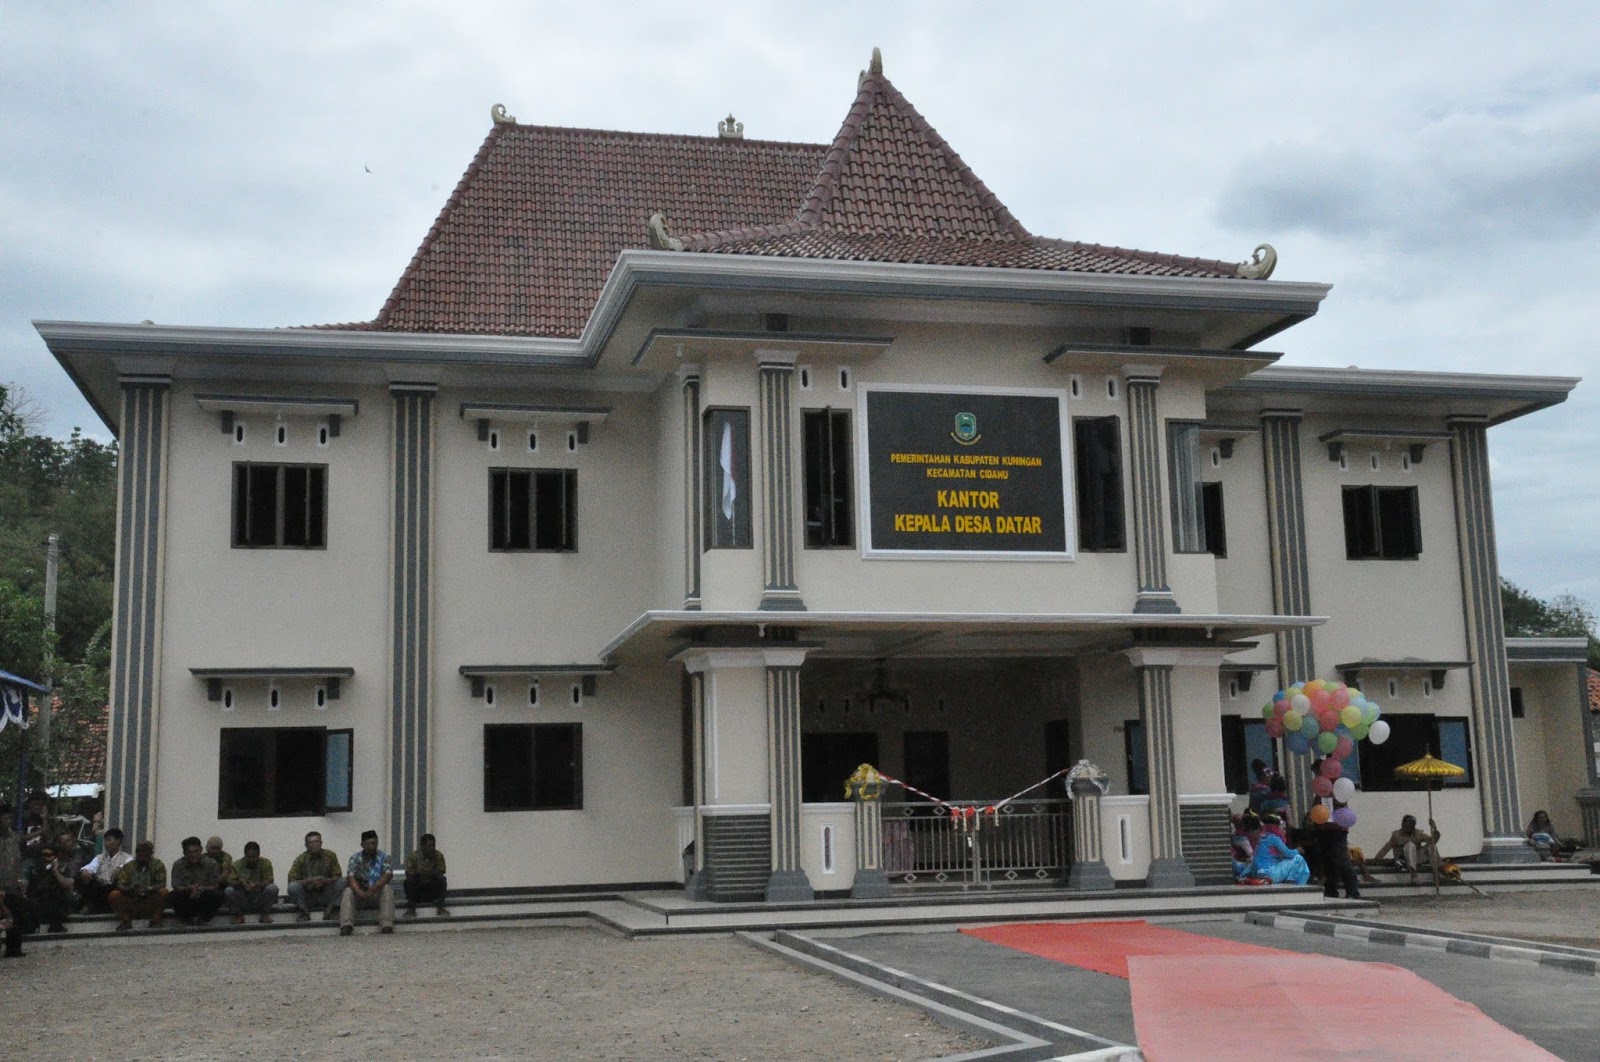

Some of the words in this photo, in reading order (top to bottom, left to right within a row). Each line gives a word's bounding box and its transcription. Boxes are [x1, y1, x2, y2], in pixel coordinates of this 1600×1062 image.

[891, 453, 950, 464] PEMERINTAHAN
[953, 454, 999, 465] KABUPATEN
[1002, 456, 1042, 466] KUNINGAN
[926, 468, 976, 479] KECAMATAN
[979, 469, 1009, 480] CIDAHU
[937, 490, 999, 509] KANTOR
[895, 514, 951, 532] KEPALA
[955, 515, 993, 533] DESA
[996, 516, 1042, 534] DATAR
